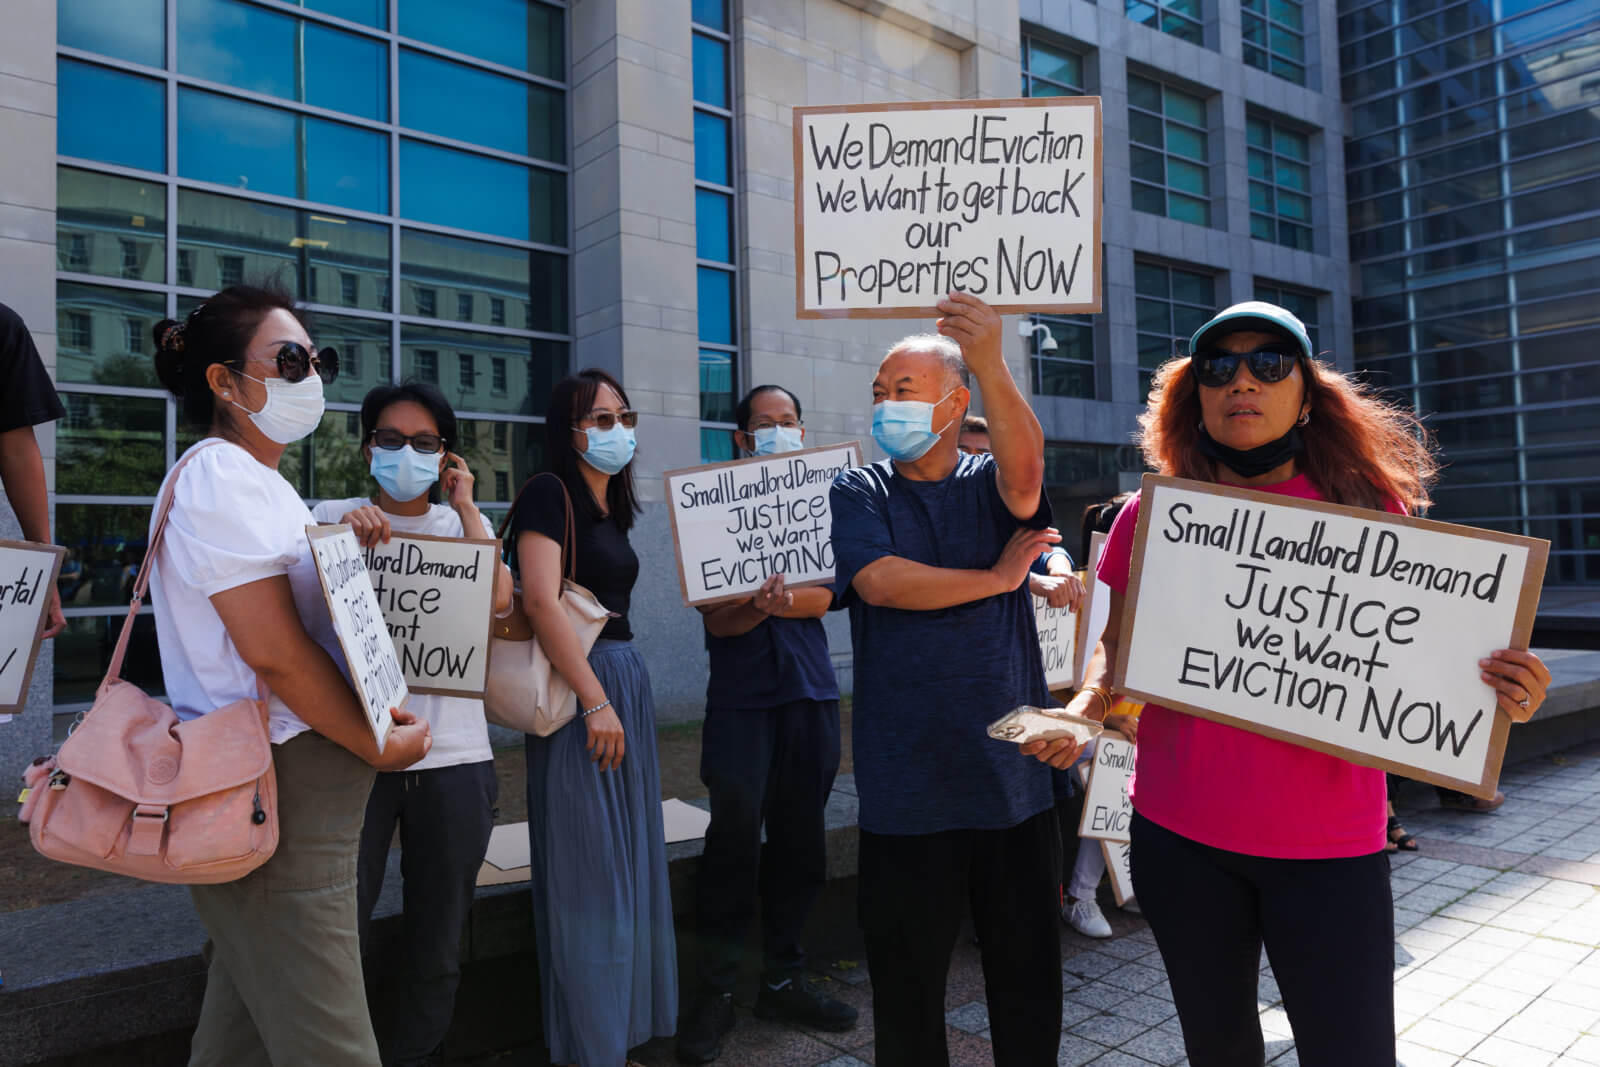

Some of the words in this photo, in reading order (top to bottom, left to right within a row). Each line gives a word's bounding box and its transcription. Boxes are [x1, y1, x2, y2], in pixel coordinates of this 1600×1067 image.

[808, 122, 863, 170] We
[869, 114, 978, 170] Demand
[979, 112, 1084, 166] Eviction
[816, 178, 857, 213] We
[860, 170, 931, 214] Want
[934, 166, 959, 213] to
[961, 167, 1008, 223] get
[905, 221, 962, 249] our
[814, 250, 989, 305] Properties
[996, 235, 1083, 296] NOW
[680, 471, 731, 509] Small
[730, 459, 795, 502] Landlord
[726, 494, 828, 534] Justice
[736, 533, 764, 554] We
[768, 518, 824, 548] Want
[1163, 502, 1250, 555] Small
[1250, 510, 1371, 576] Landlord
[1369, 529, 1508, 603] Demand
[406, 544, 480, 582] Demand
[801, 541, 837, 574] NO
[0, 566, 43, 605] rtal
[374, 574, 441, 614] tice
[1224, 563, 1421, 645] Justice
[384, 613, 421, 641] ant
[402, 643, 475, 679] NOW
[1236, 617, 1284, 656] We
[1294, 628, 1390, 682] Want
[1358, 686, 1484, 758] NOW
